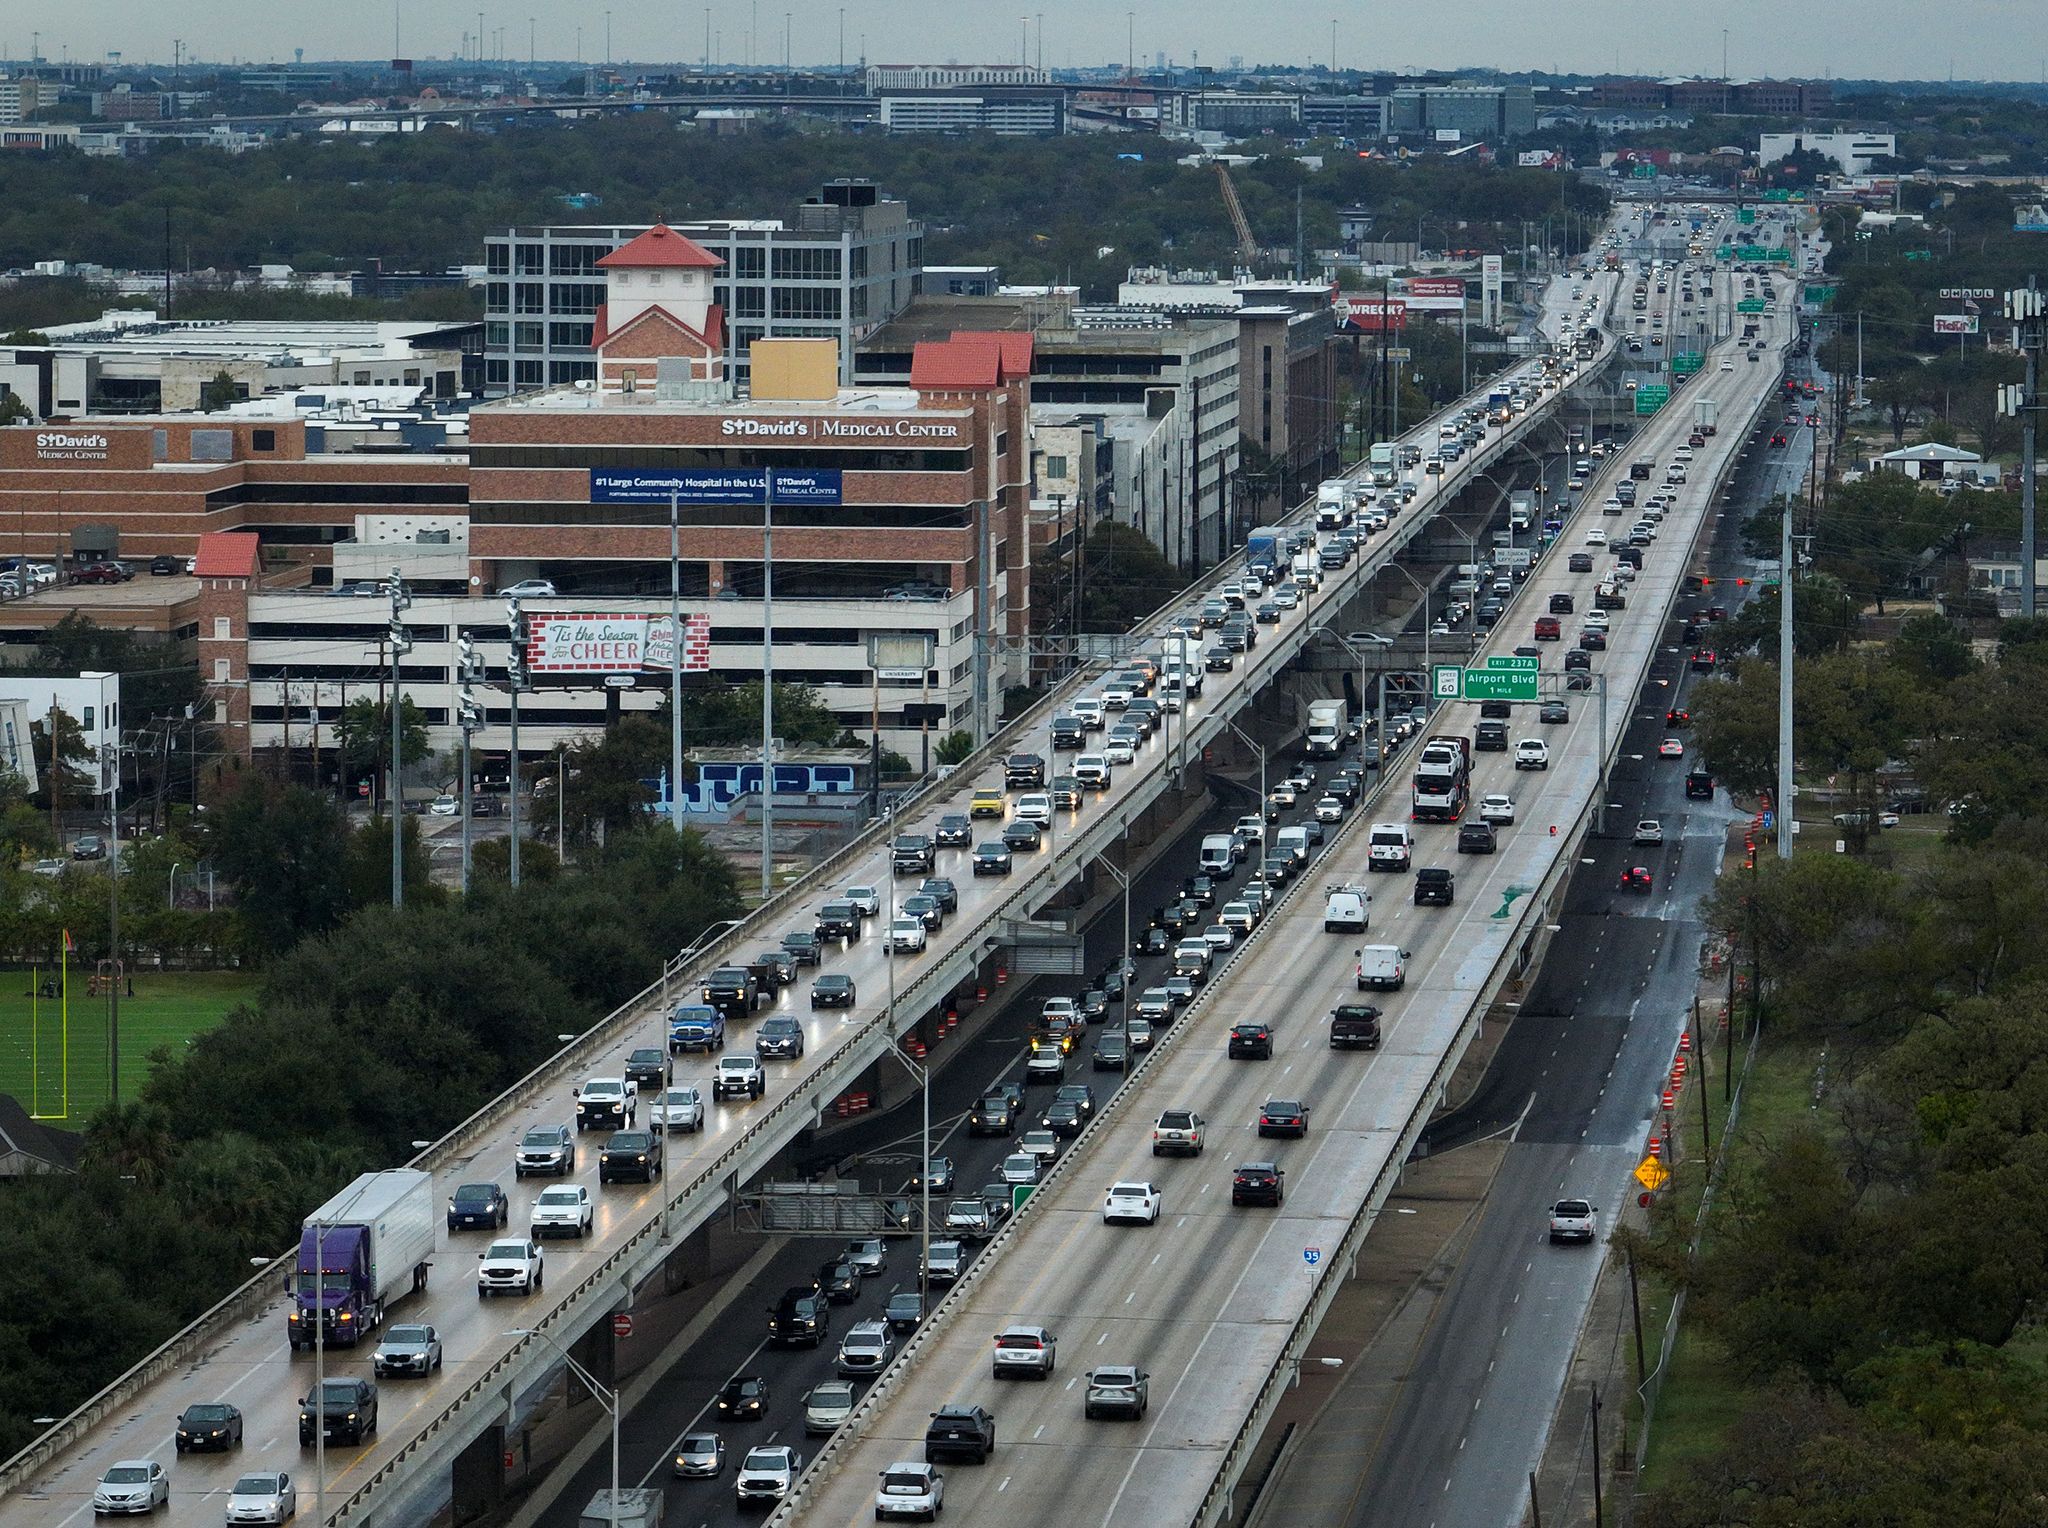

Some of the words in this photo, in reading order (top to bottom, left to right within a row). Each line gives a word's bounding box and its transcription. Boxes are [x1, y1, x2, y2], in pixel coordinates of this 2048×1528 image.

[596, 478, 606, 486] #1
[608, 478, 632, 488] Large
[634, 478, 684, 488] Community
[685, 478, 722, 488] Hospital
[724, 478, 732, 487] in
[733, 478, 748, 487] the
[574, 625, 594, 640] the
[598, 625, 638, 640] Season
[552, 646, 570, 658] For
[570, 643, 638, 660] CHEER
[1468, 674, 1506, 684] Airport
[1512, 674, 1535, 684] Blvd
[1442, 684, 1454, 692] 60
[1306, 1252, 1318, 1260] 35
